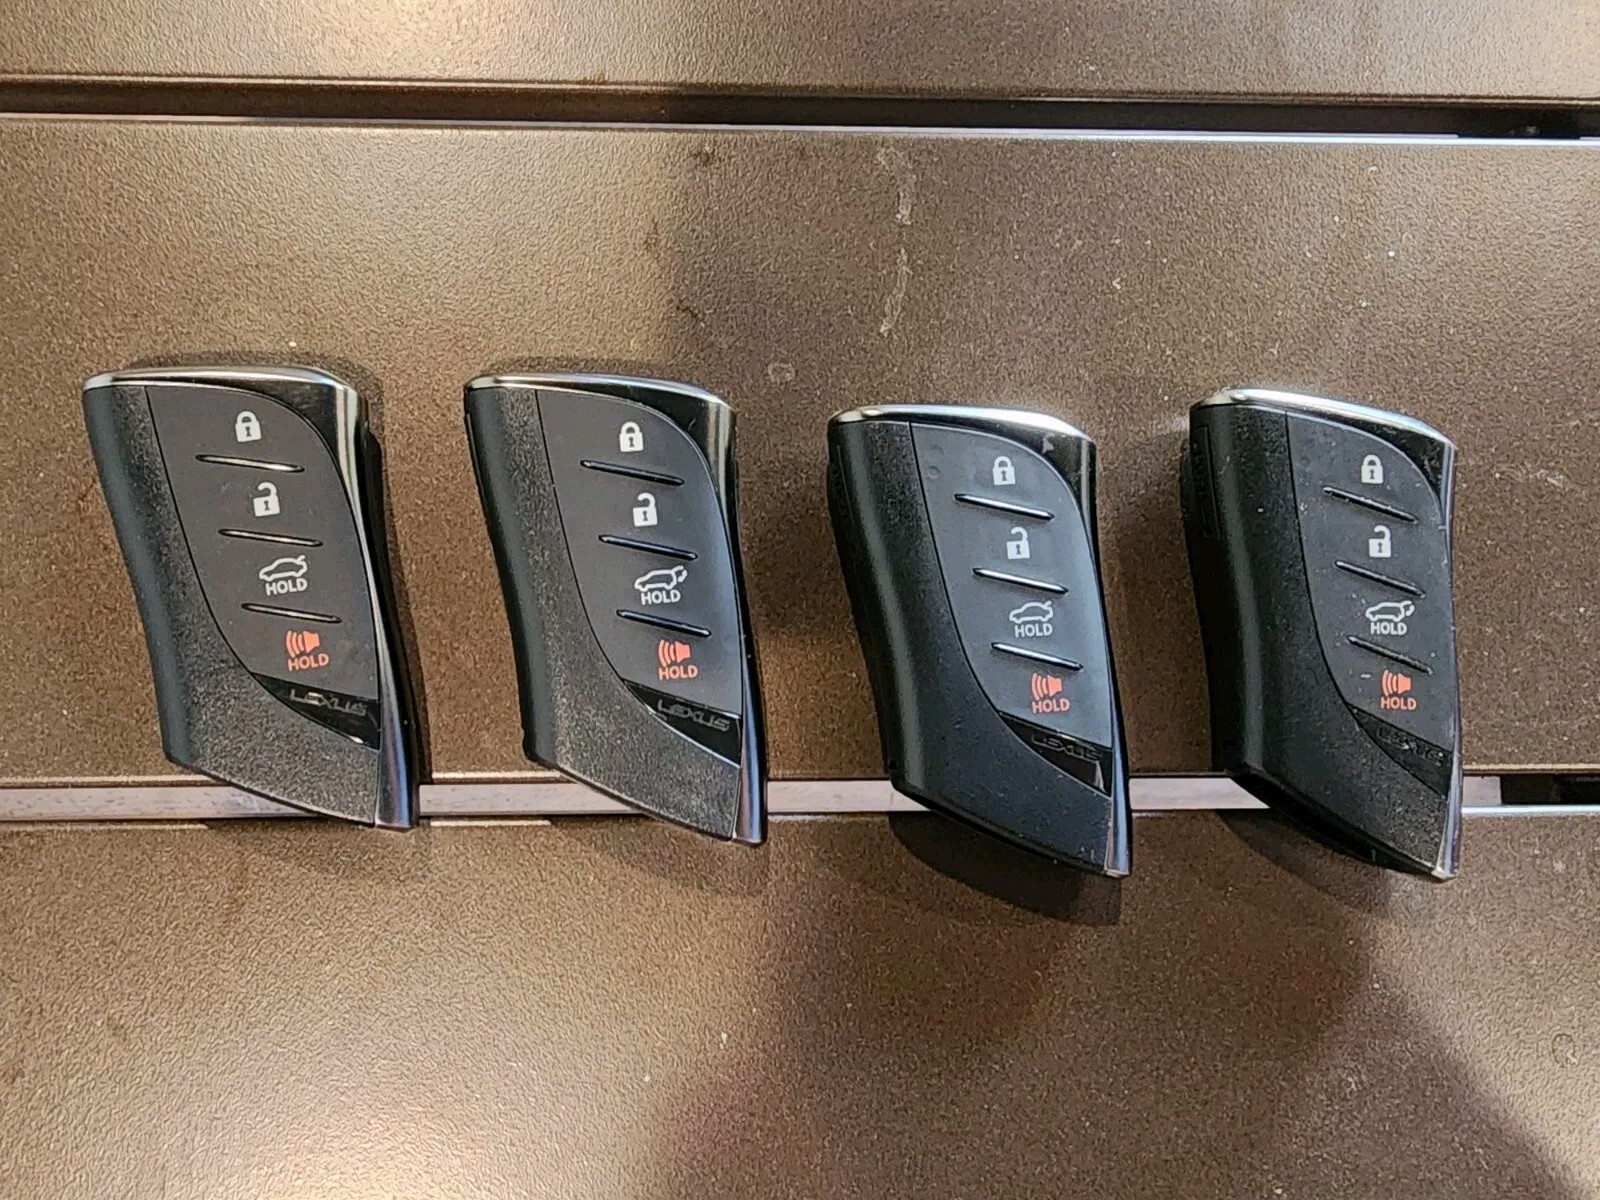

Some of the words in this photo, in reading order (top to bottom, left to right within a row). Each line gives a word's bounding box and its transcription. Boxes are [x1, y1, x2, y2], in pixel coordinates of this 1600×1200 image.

[265, 578, 308, 596] HOLD
[641, 590, 681, 605] HOLD
[1014, 623, 1053, 638] HOLD
[1370, 622, 1407, 636] HOLD
[287, 653, 330, 671] HOLD
[658, 665, 698, 680] HOLD
[289, 688, 368, 717] LEXUS
[1031, 698, 1071, 714] HOLD
[1380, 697, 1417, 710] HOLD
[656, 698, 730, 732] LEXUS
